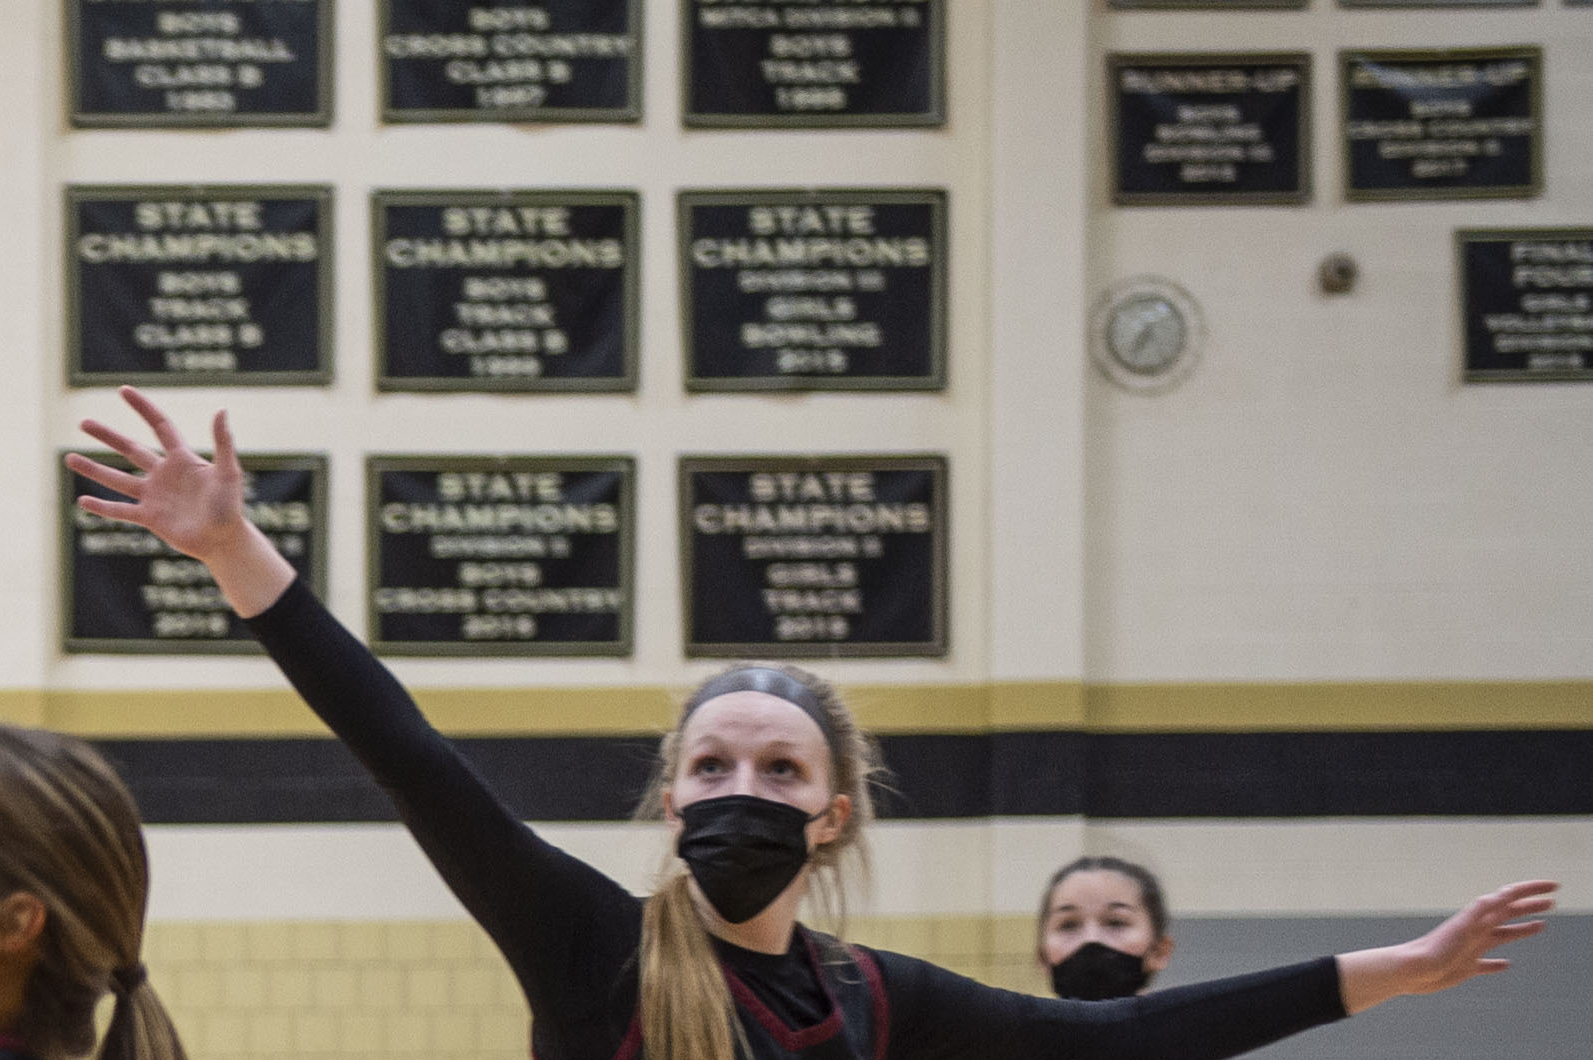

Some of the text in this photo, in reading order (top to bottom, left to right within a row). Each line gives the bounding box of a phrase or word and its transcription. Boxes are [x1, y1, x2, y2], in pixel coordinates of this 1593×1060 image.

[135, 202, 261, 230] STATE
[442, 207, 569, 235] STATE
[749, 207, 875, 235] STATE
[80, 233, 318, 262] CHAMPIONS
[386, 238, 622, 268] CHAMPIONS
[693, 238, 929, 268] CHAMPIONS
[437, 472, 561, 499] STATE
[749, 472, 876, 500] STATE
[381, 503, 618, 533] CHAMPIONS
[693, 503, 930, 534] CHAMPIONS
